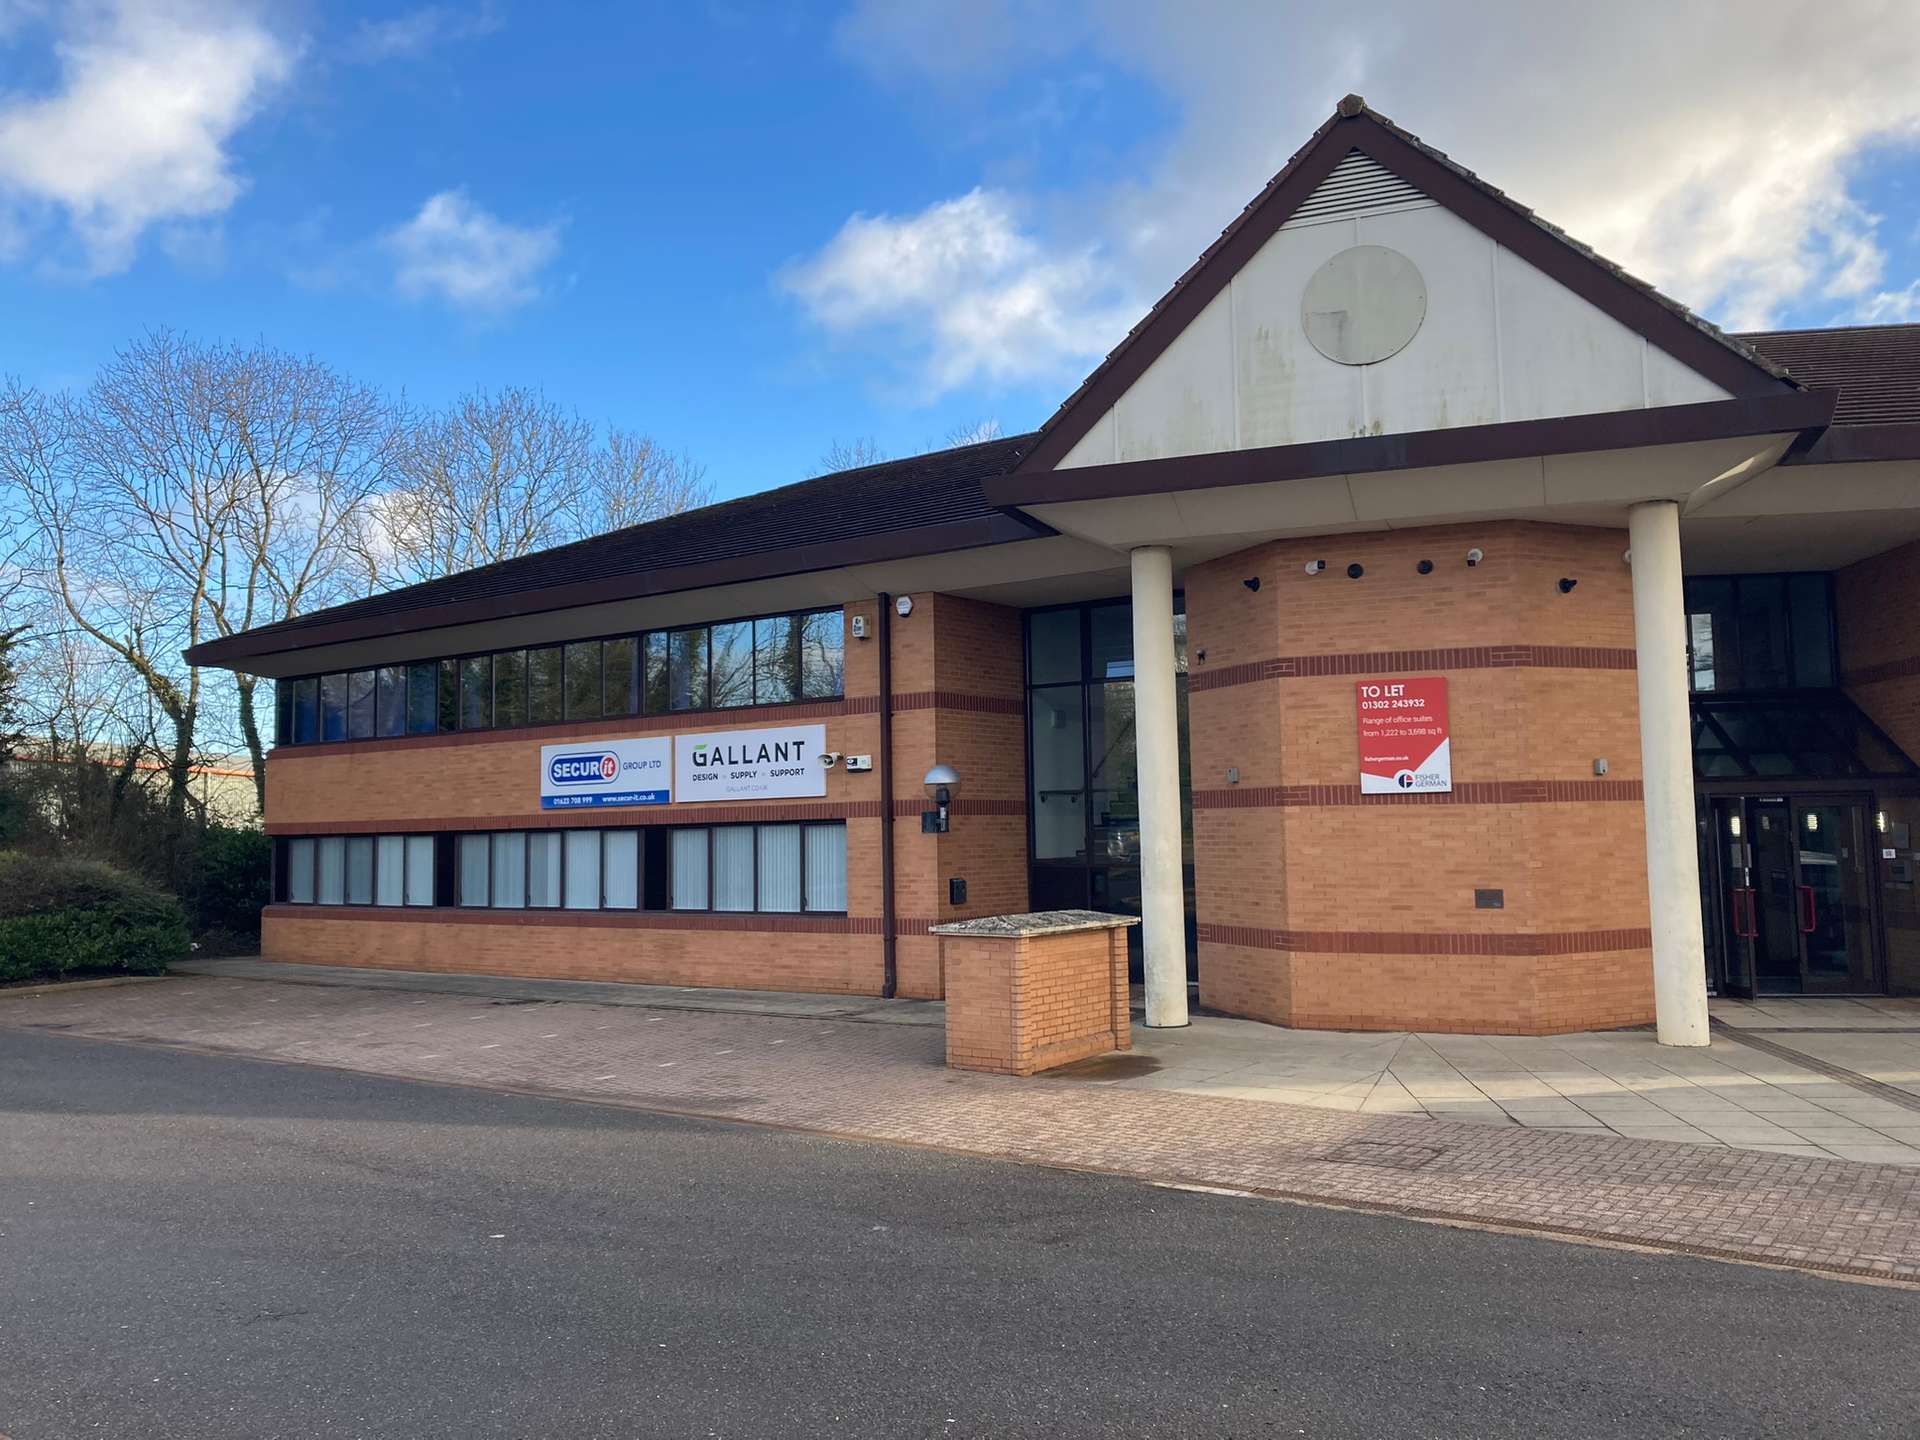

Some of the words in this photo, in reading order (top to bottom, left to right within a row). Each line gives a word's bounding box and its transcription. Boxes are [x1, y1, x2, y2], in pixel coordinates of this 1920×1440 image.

[1361, 686, 1380, 698] TO
[1384, 685, 1405, 696] LET
[1362, 700, 1389, 709] 01302
[1392, 699, 1425, 709] 243932
[1363, 717, 1384, 725] Range
[1385, 716, 1392, 724] of
[1393, 715, 1412, 723] office
[1400, 728, 1407, 736] to
[692, 741, 805, 767] GALLANT
[623, 761, 647, 770] GROUP
[649, 760, 661, 769] LTD
[692, 773, 718, 781] DESIGN
[730, 771, 757, 779] SUPPLY
[770, 768, 805, 777] SUPPORT
[582, 796, 593, 804] 999
